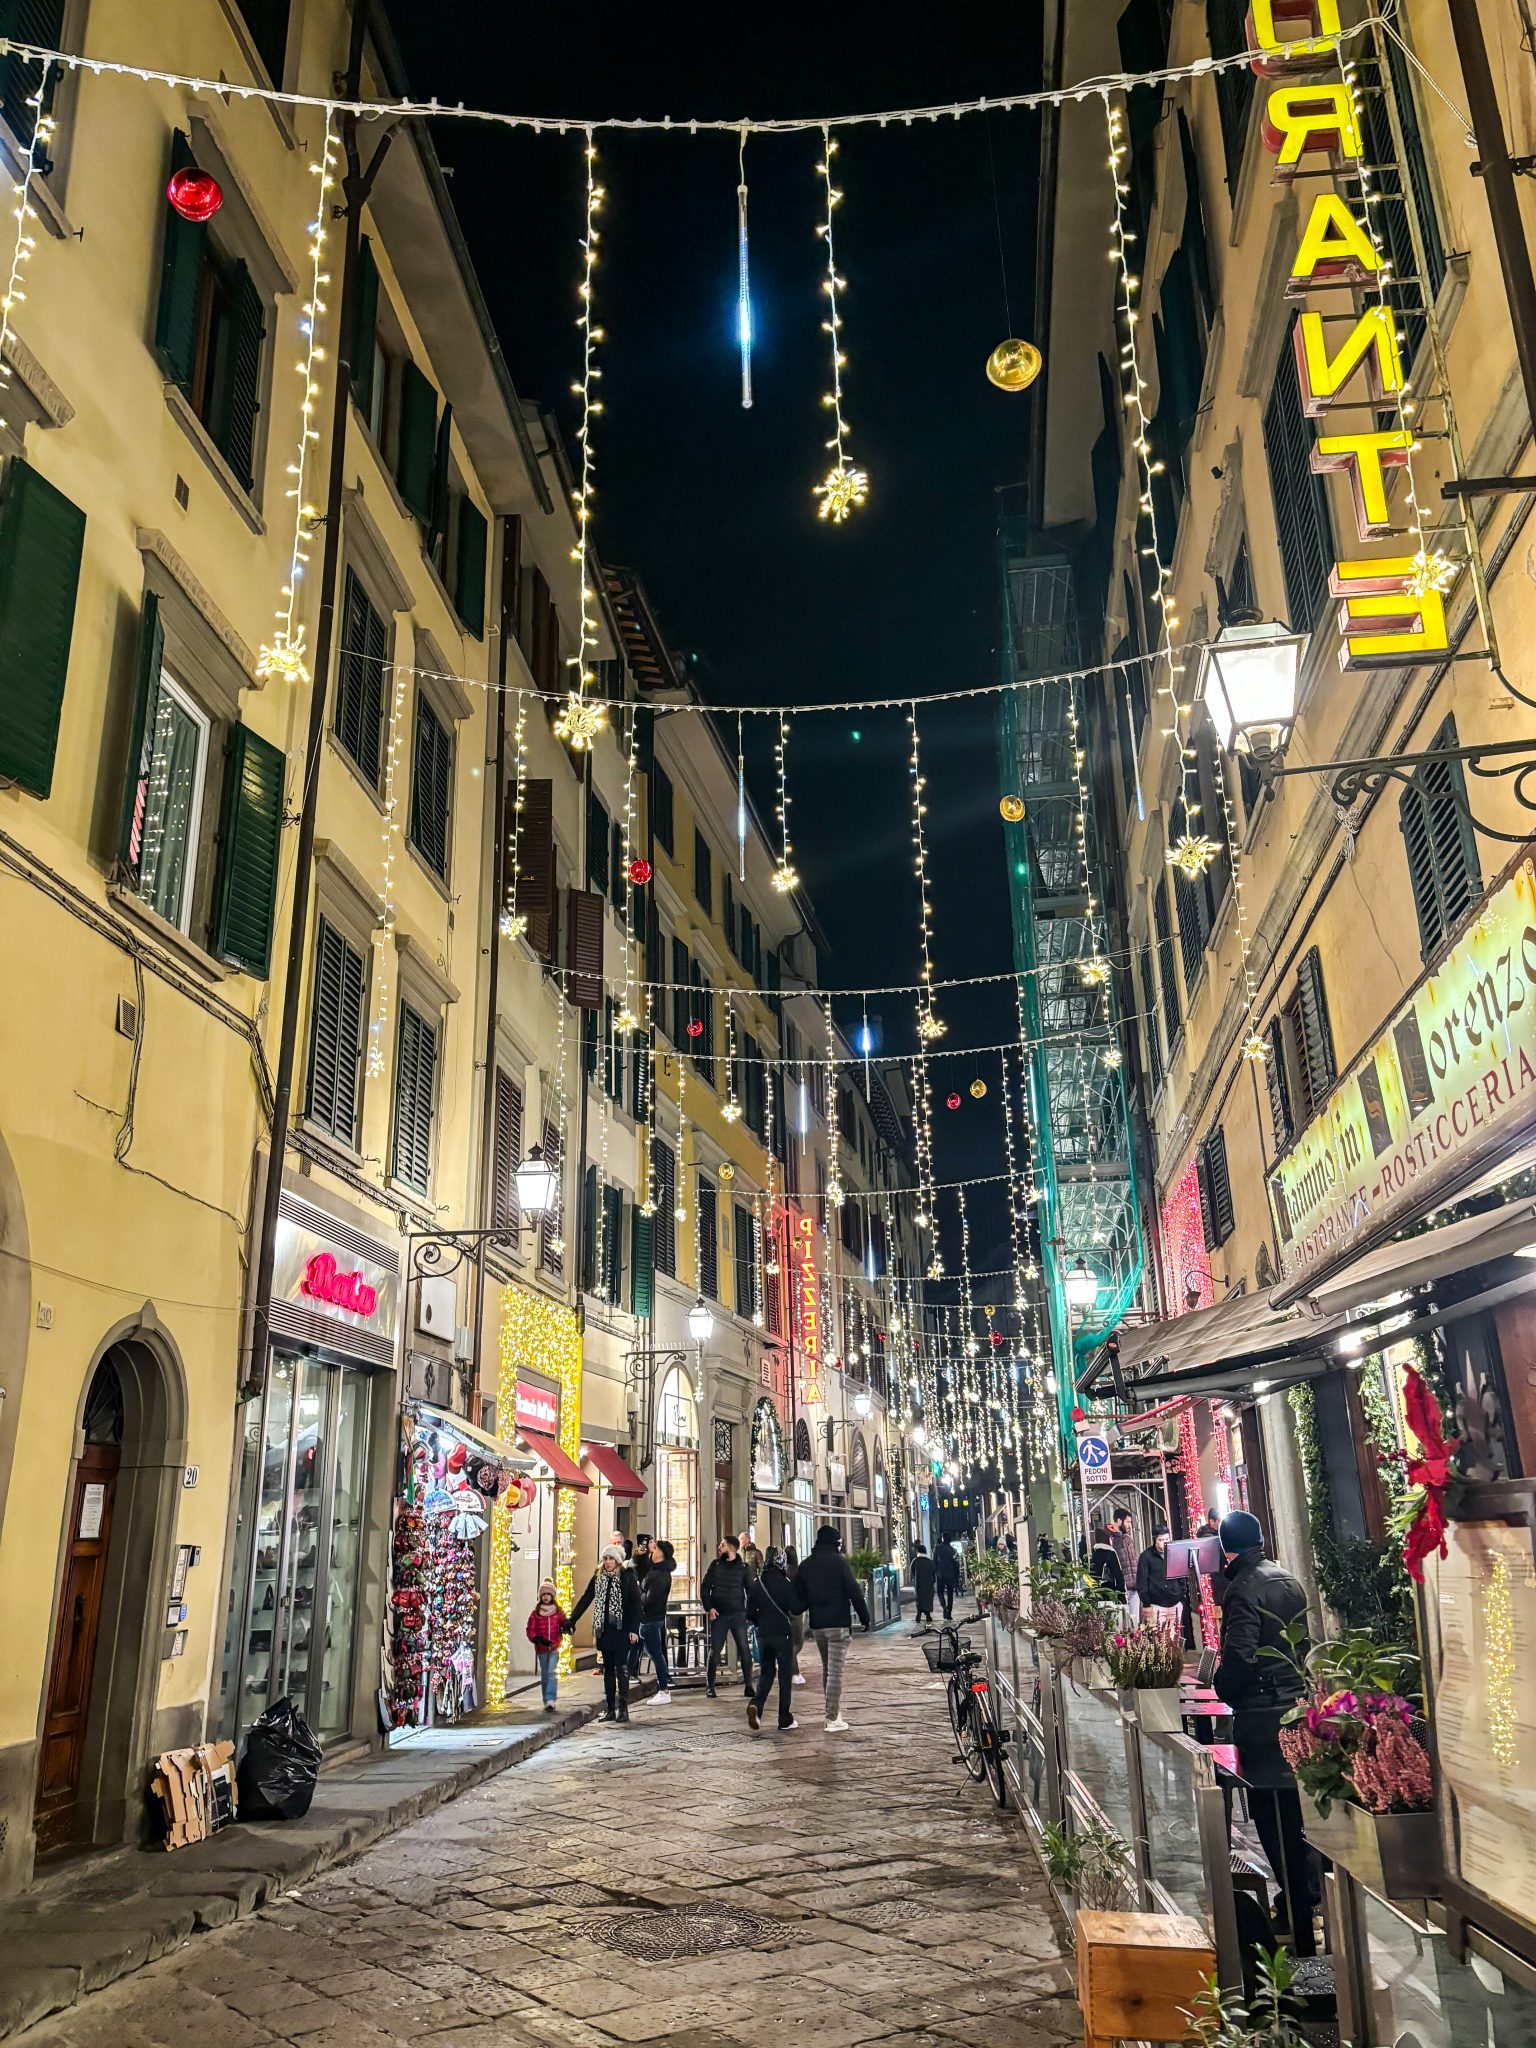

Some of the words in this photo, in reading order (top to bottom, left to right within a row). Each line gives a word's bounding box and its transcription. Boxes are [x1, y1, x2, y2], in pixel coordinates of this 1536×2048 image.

[1381, 1045, 1536, 1199] ROSTICCERIA
[1272, 1145, 1336, 1246] iannino
[1335, 1109, 1362, 1172] in
[186, 1467, 198, 1485] 20
[1084, 1467, 1108, 1475] PEDONI
